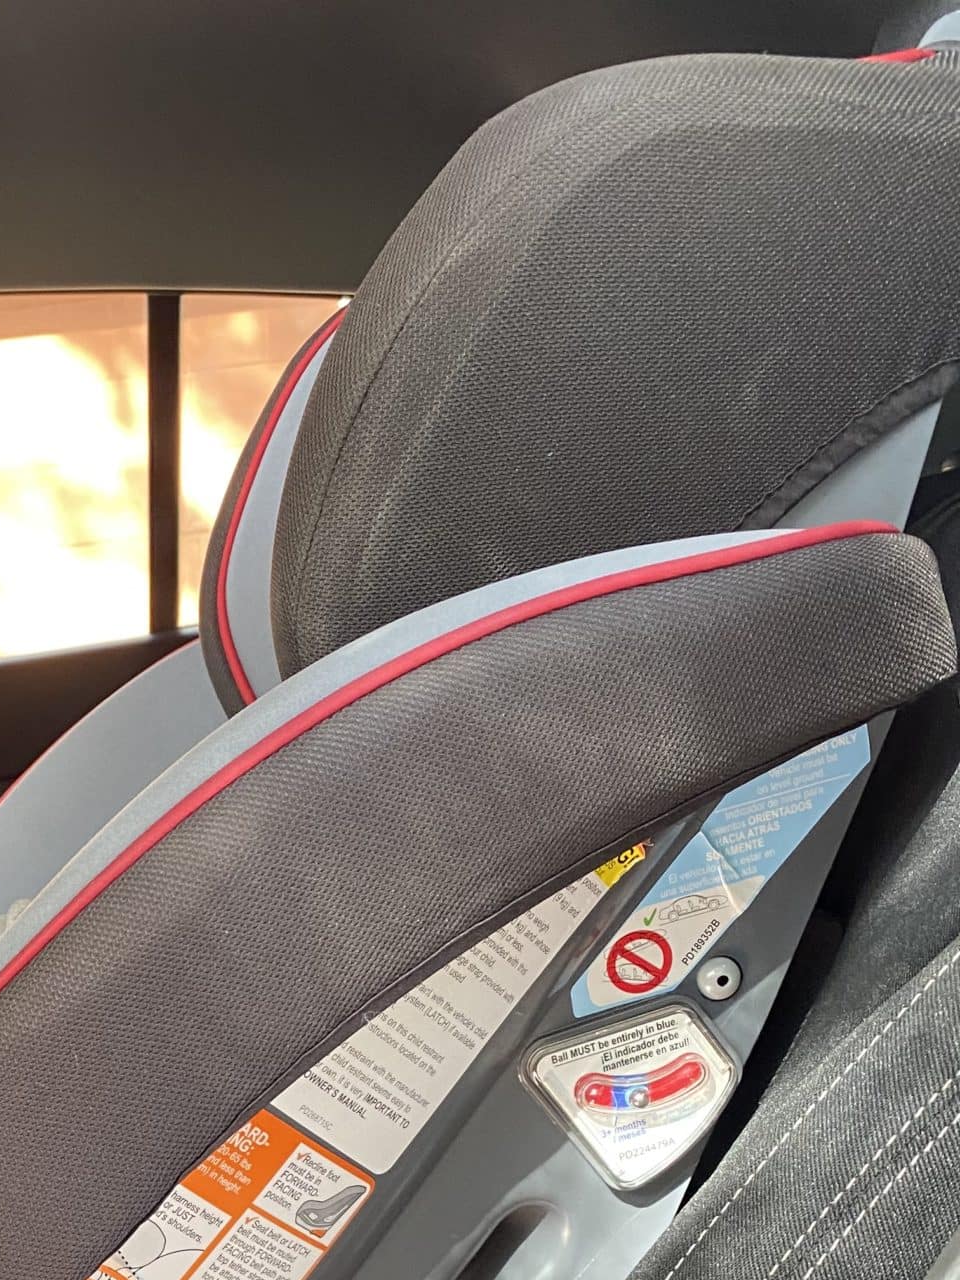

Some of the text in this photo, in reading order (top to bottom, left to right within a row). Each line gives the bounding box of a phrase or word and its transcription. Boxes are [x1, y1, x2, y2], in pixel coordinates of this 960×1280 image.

[829, 732, 858, 748] ONLY
[745, 798, 813, 825] ORIENTADOS
[521, 928, 537, 944] and
[680, 917, 721, 966] PD189352B
[421, 1005, 453, 1033] (LATCH)
[384, 1016, 399, 1030] on
[393, 1021, 411, 1039] this
[404, 1030, 425, 1049] child
[418, 1040, 447, 1065] restraint
[549, 1016, 679, 1065] Ball MUST be entirely in blue.
[598, 1030, 680, 1064] ¡El indicador debe
[600, 1049, 656, 1072] mantenerse
[654, 1044, 668, 1056] en
[301, 1067, 341, 1099] OWNER'S
[328, 1050, 413, 1115] child restraint seems easy to
[346, 1083, 411, 1130] very IMPORTANT TO
[612, 1117, 647, 1134] months
[616, 1126, 647, 1142] meses
[236, 1155, 254, 1172] lbs
[617, 1137, 677, 1161] PD224479A
[207, 1168, 219, 1181] in
[217, 1158, 238, 1176] less
[233, 1168, 254, 1187] than
[278, 1167, 322, 1200] FORWARD-
[286, 1159, 323, 1188] must be in
[300, 1153, 342, 1185] Recline foot
[271, 1177, 303, 1203] FACING
[161, 1199, 196, 1224] or JUST
[168, 1190, 224, 1230] harness height
[165, 1216, 204, 1244] shoulders.
[235, 1223, 298, 1265] belt must be routed
[249, 1217, 312, 1259] Seat belt or LATCH
[220, 1241, 253, 1265] FACING
[248, 1256, 265, 1272] belt
[259, 1264, 278, 1280] path
[227, 1232, 294, 1276] through FORWARD-
